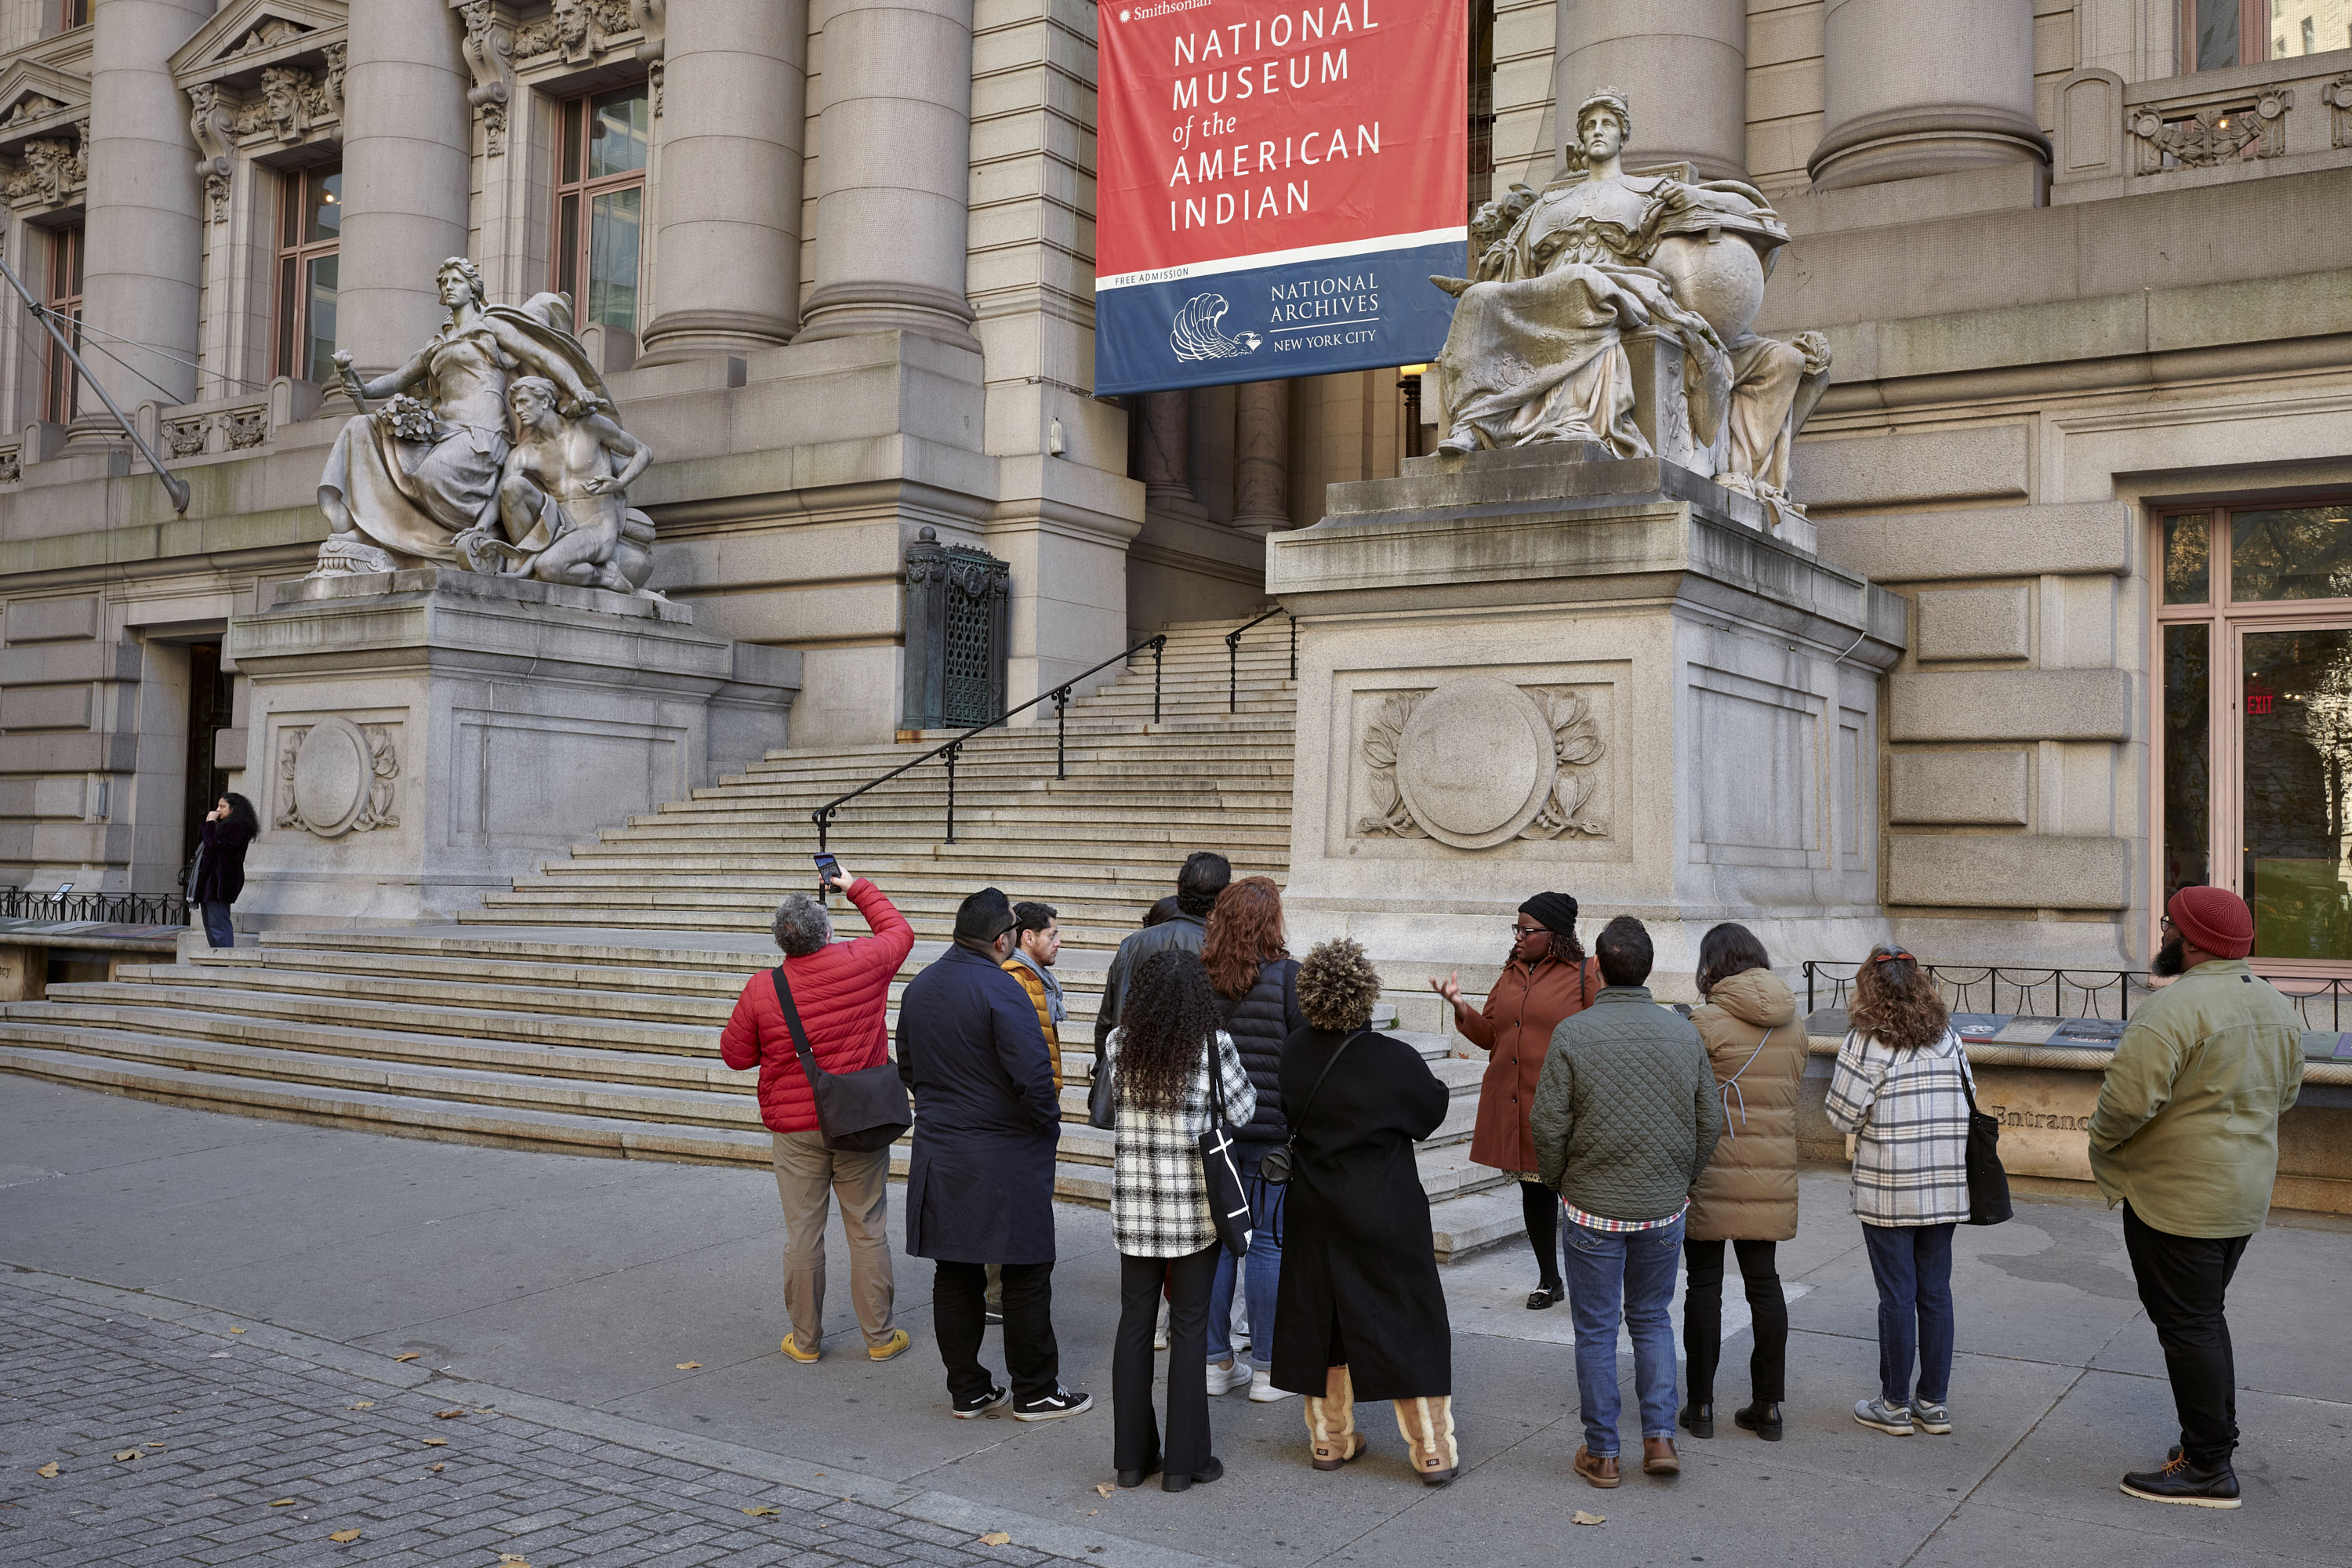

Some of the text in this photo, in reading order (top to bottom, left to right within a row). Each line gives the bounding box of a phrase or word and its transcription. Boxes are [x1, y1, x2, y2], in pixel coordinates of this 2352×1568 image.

[1174, 0, 1378, 67] NATIONAL
[1173, 48, 1348, 111] MUSEUM
[1172, 111, 1236, 150] of the
[1169, 122, 1380, 187] AMERICAN
[1171, 180, 1308, 232] INDIAN
[1115, 267, 1189, 285] FREE ADMISSION
[1271, 273, 1379, 302] NATIONAL
[1269, 293, 1379, 323] ARCHIVES
[1274, 329, 1377, 352] NEW YORK CITY
[2247, 695, 2274, 714] EXIT
[1991, 1105, 2089, 1131] Entranc
